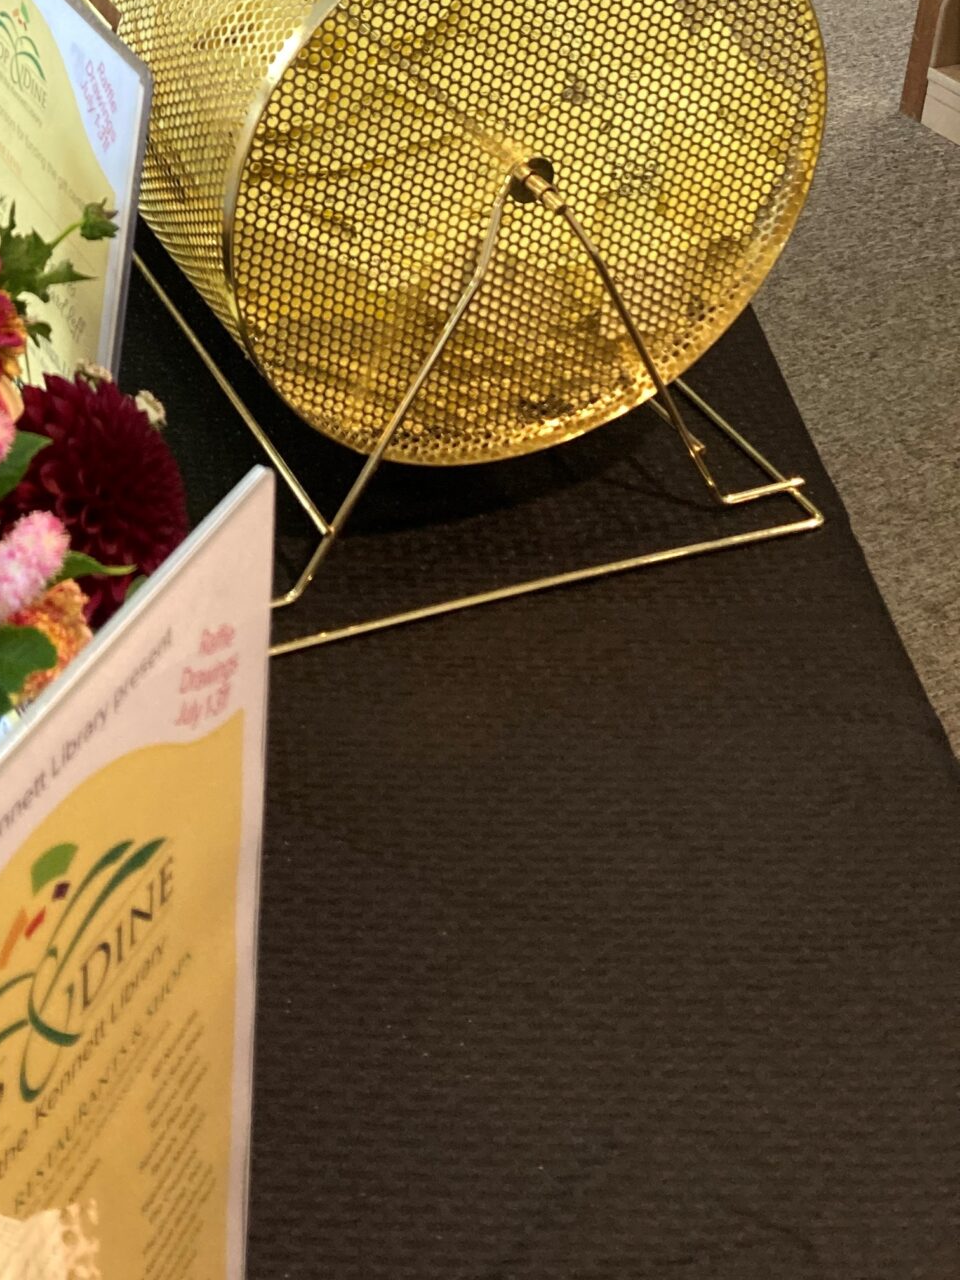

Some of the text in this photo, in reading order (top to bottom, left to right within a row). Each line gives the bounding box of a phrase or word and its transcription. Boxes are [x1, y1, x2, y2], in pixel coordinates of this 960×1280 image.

[22, 64, 48, 110] DINE
[50, 707, 110, 779] Library
[113, 626, 174, 713] present
[79, 855, 177, 1012] DINE
[35, 1020, 107, 1130] Kennett
[110, 937, 165, 1024] Library
